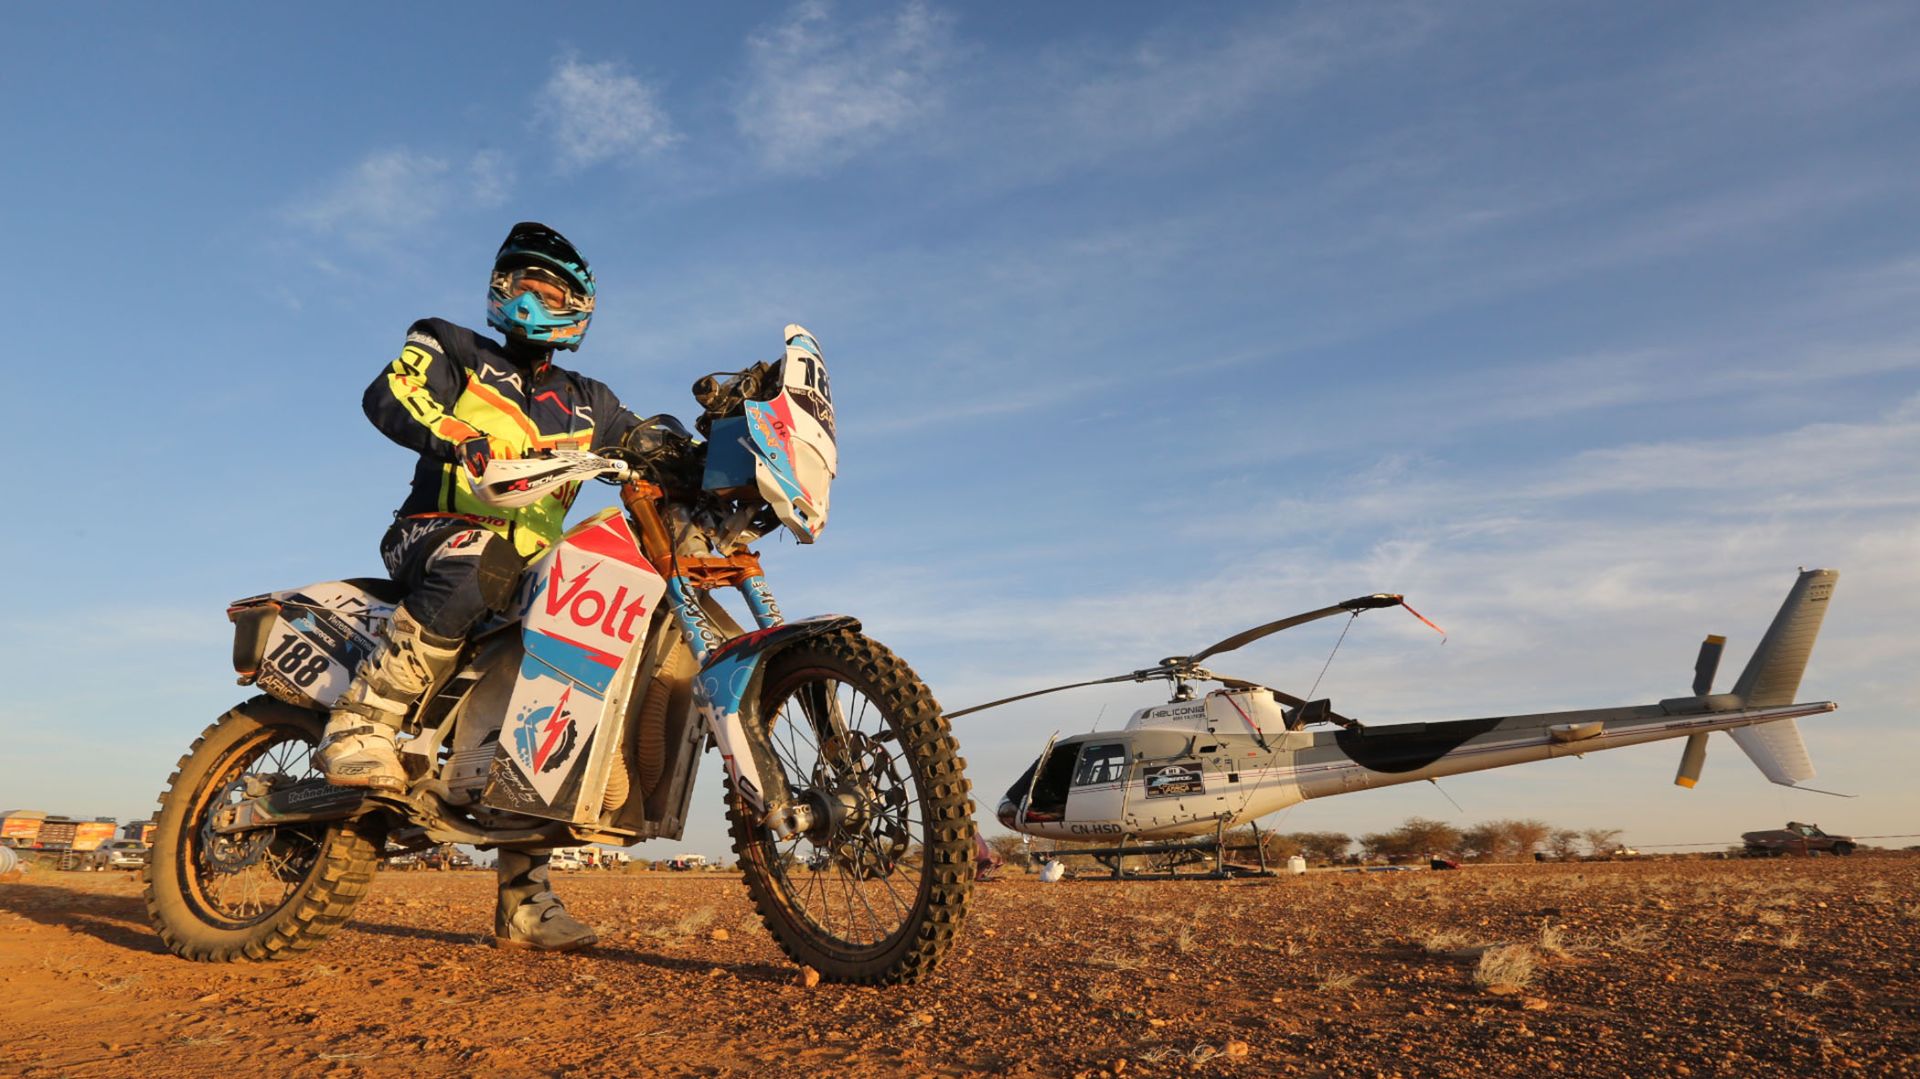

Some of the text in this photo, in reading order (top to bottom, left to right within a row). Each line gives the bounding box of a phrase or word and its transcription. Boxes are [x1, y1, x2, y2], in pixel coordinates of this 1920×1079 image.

[545, 548, 647, 643] Volt
[266, 633, 330, 687] 188
[1070, 823, 1122, 835] CN-HSD
